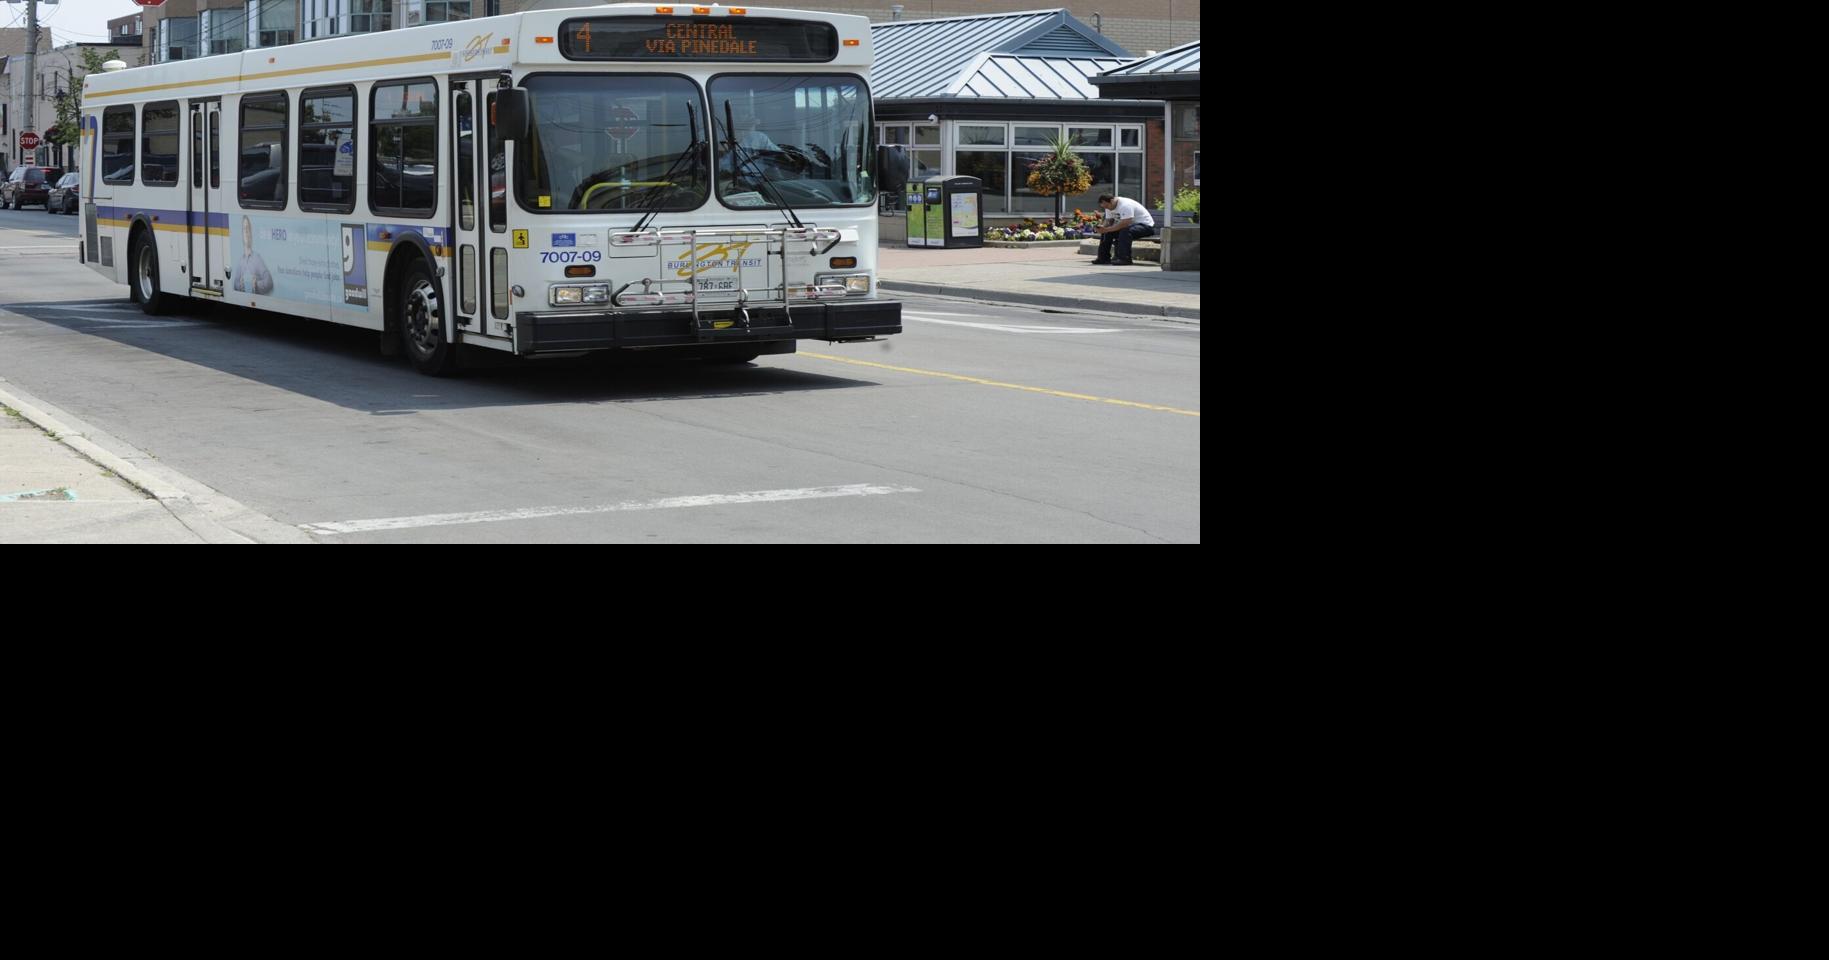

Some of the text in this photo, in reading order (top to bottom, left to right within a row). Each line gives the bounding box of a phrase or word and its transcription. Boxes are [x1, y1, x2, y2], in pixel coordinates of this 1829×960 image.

[576, 22, 592, 52] 4
[666, 24, 736, 39] CENTRAL
[432, 38, 453, 50] 7007-09
[645, 39, 757, 54] VIA PINEDALE
[271, 228, 287, 240] HERO
[540, 251, 601, 263] 7007-09
